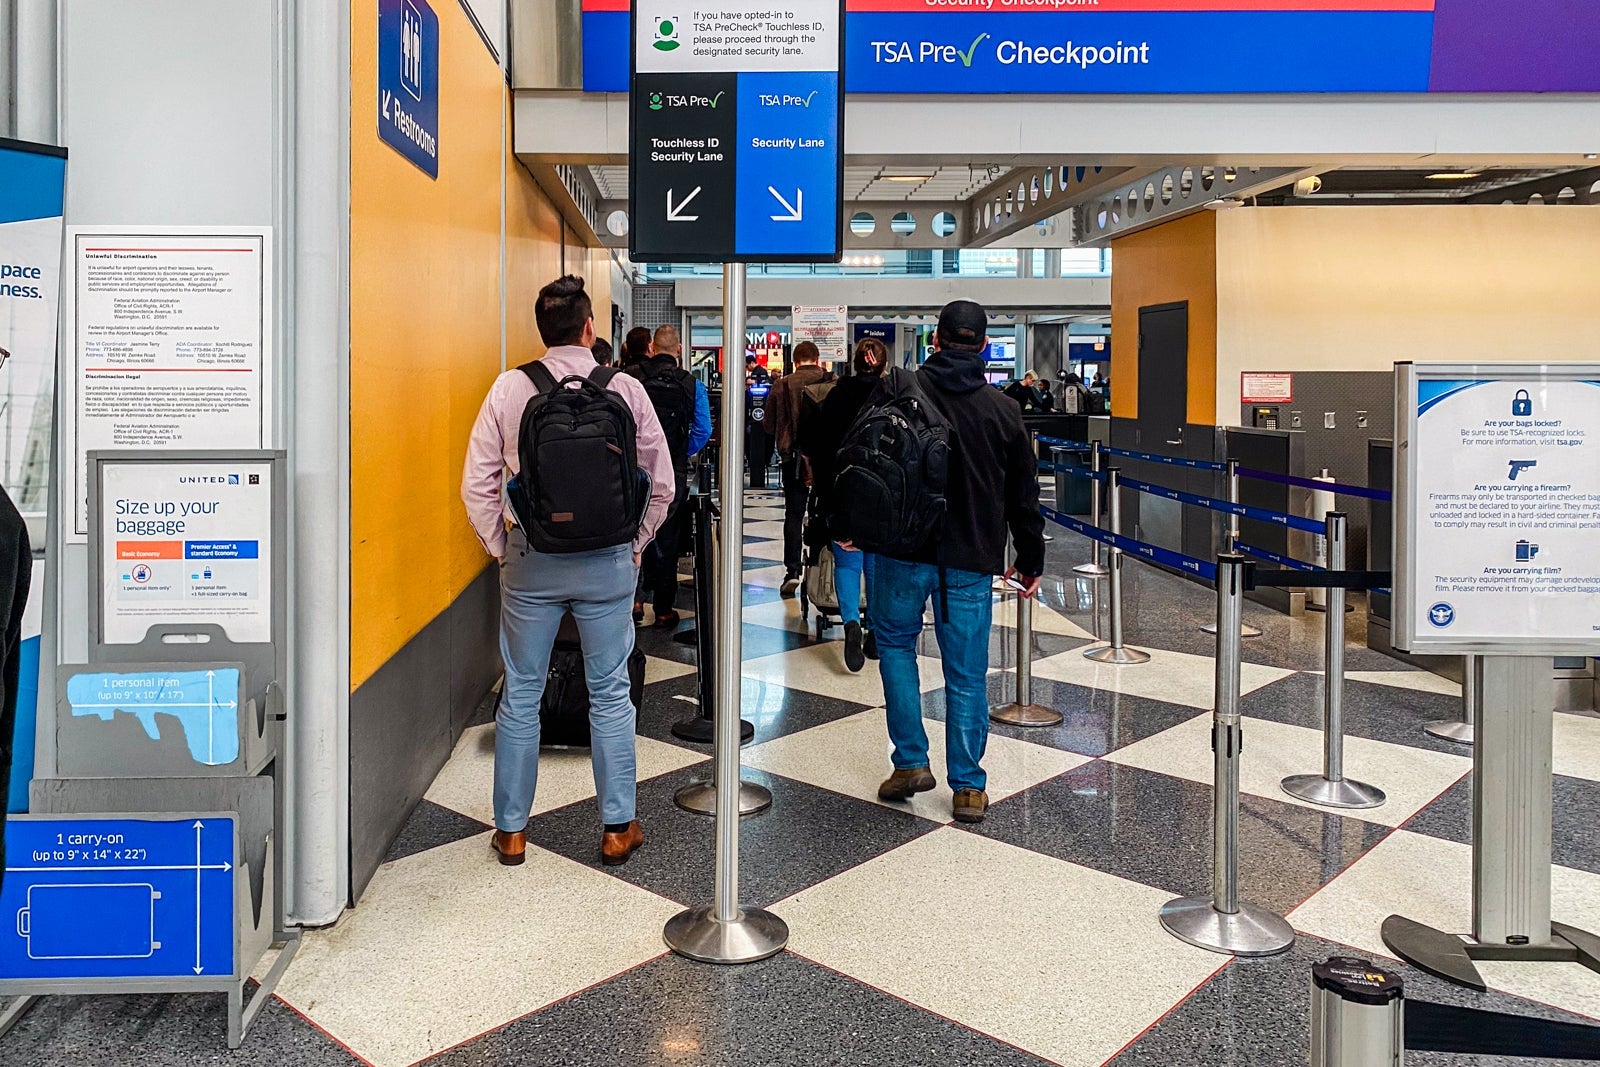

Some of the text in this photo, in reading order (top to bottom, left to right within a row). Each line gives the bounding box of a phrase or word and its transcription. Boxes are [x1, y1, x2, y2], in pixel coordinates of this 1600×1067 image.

[702, 13, 718, 21] you
[744, 11, 782, 20] opted-in
[693, 22, 824, 31] TSA PreCheck® Touchless ID,
[694, 36, 722, 45] please
[725, 35, 761, 45] proceed
[764, 35, 798, 44] through
[693, 47, 742, 57] designated
[745, 47, 780, 56] security
[871, 40, 1150, 69] TSA Pre Checkpoint
[666, 96, 708, 106] TSA Pre
[759, 95, 801, 105] TSA Pre
[395, 98, 436, 158] Restrooms
[651, 138, 719, 147] Touchless ID
[752, 138, 824, 149] Security Lane
[652, 152, 723, 162] Security Lane
[1, 264, 41, 279] pace
[0, 284, 42, 298] ness.
[1510, 429, 1564, 437] TSA-recognized
[1503, 484, 1533, 492] carrying
[116, 499, 219, 516] Size up your
[1563, 503, 1581, 511] They
[116, 518, 185, 535] baggage
[103, 678, 179, 689] 1 personal item
[57, 834, 123, 846] 1 carry-on
[33, 850, 50, 861] (up
[53, 851, 64, 860] to
[68, 850, 79, 860] 9"
[94, 850, 111, 859] 14"
[125, 849, 146, 860] 22")
